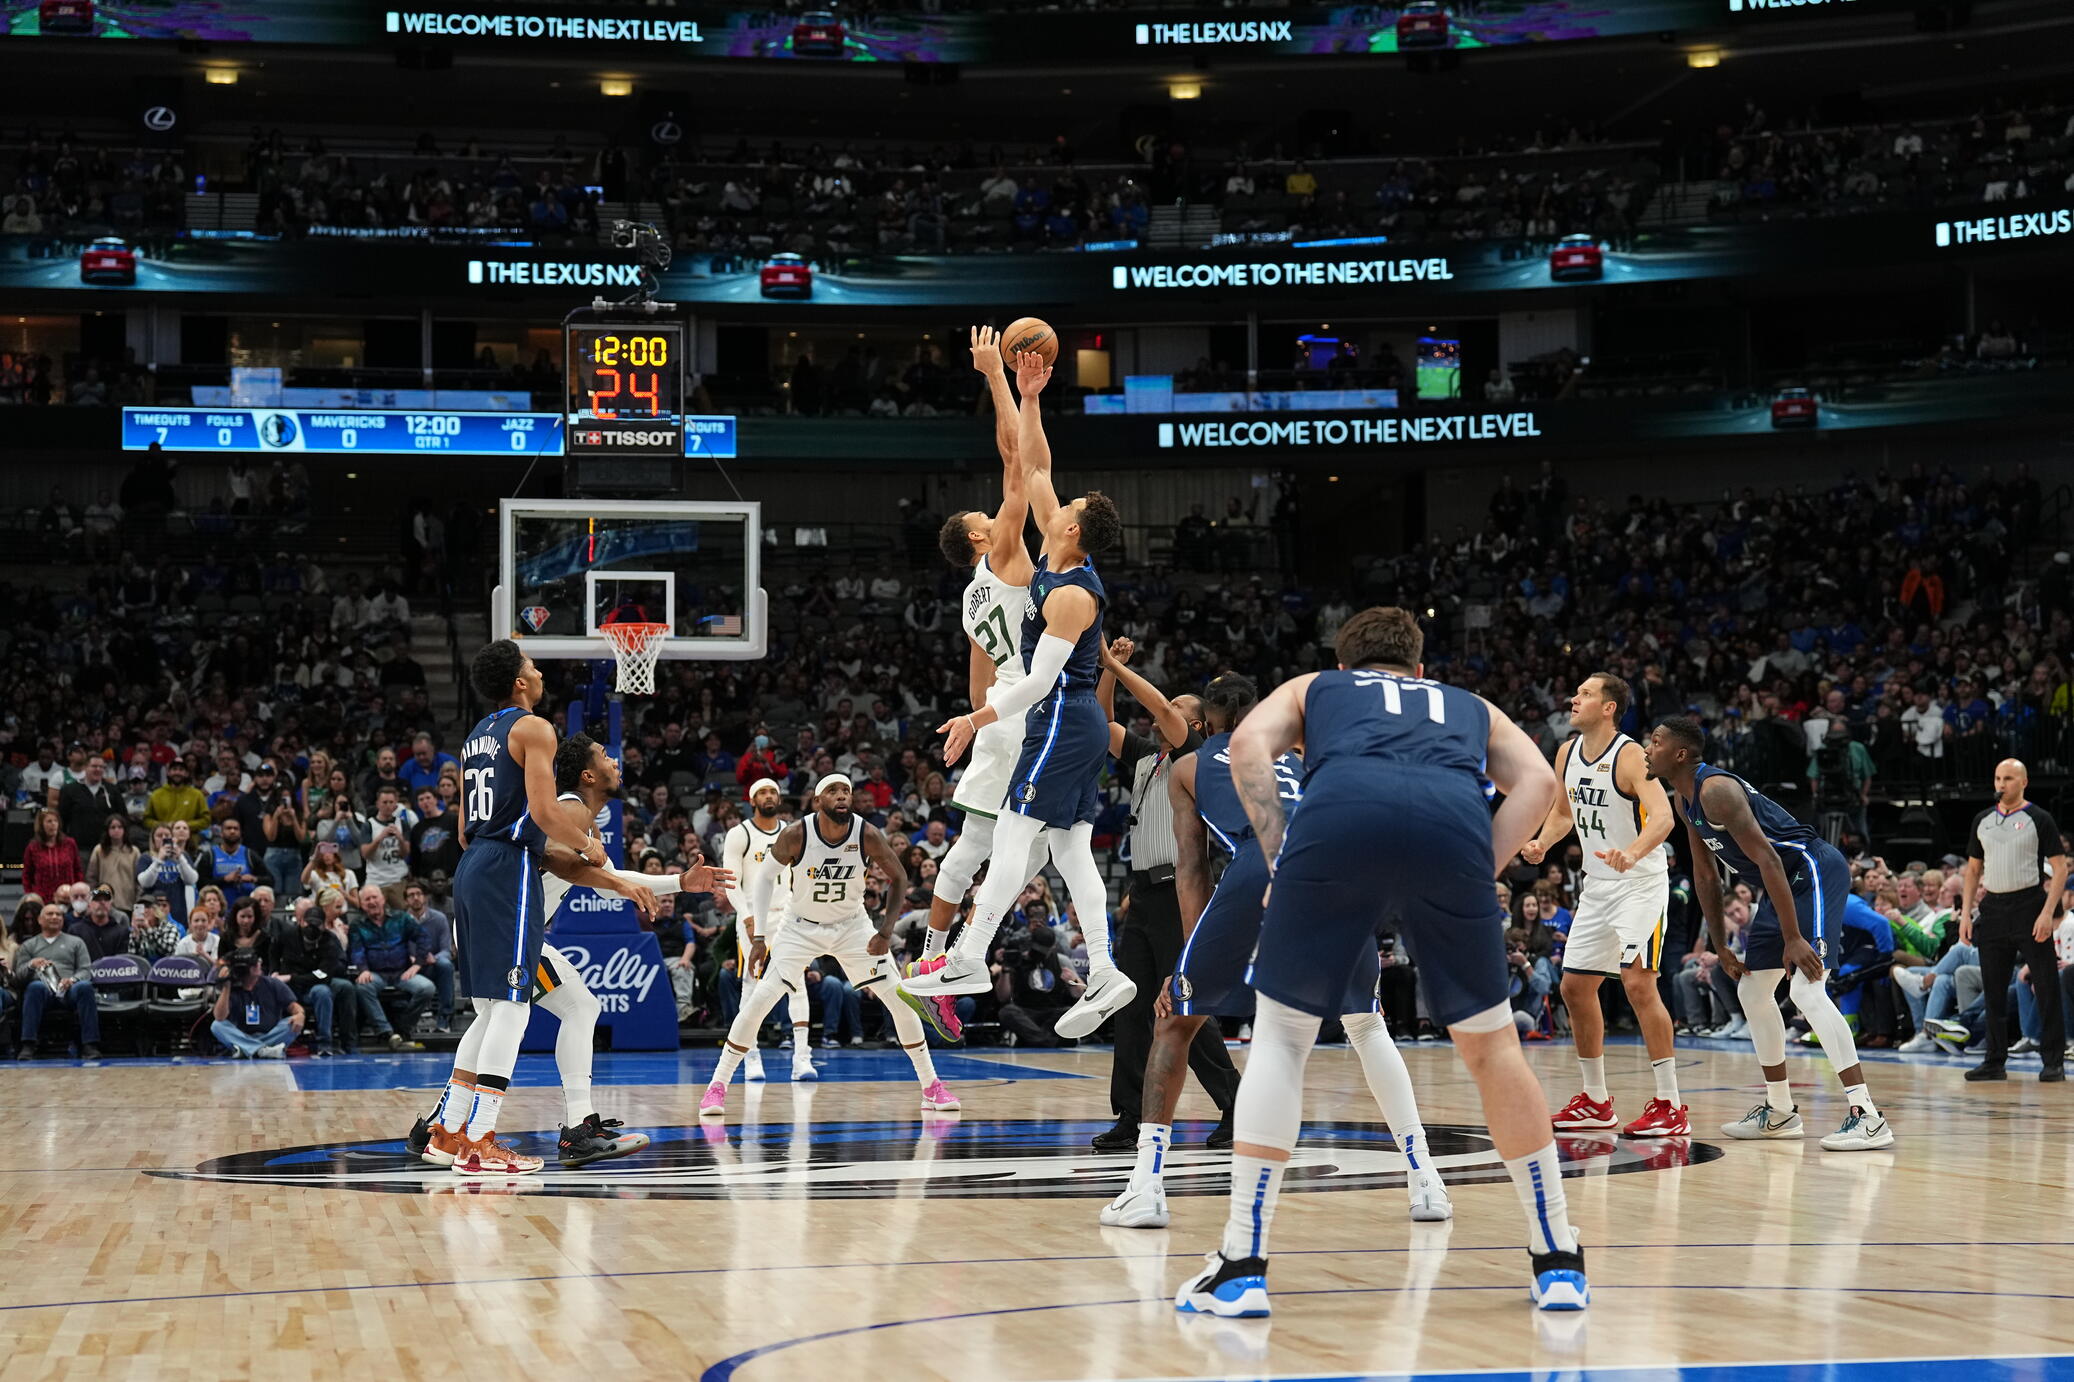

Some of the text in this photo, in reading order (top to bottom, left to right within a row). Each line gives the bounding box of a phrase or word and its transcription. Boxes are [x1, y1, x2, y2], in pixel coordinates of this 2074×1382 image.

[402, 12, 704, 42] WELCOME TO THE NEXT LEVEL
[1152, 21, 1293, 44] THE LEXUS NX
[1953, 209, 2072, 244] THE LEXUS
[487, 262, 642, 287] THE LEXUS NX
[1131, 258, 1454, 288] WELCOME TO THE NEXT LEVEL
[595, 336, 668, 366] 12:00
[1010, 331, 1046, 355] Wilson
[592, 369, 659, 418] 24
[133, 413, 244, 427] TIMEOUTS FOULS
[310, 415, 386, 429] MAVERICKS
[405, 416, 461, 436] 12:00
[501, 418, 535, 431] JAZZ
[1178, 412, 1541, 446] WELCOME TO THE NEXT LEVEL
[156, 428, 168, 445] 7
[218, 428, 232, 446] 0
[341, 428, 357, 448] 0
[415, 436, 442, 448] QTR
[510, 431, 526, 450] 0
[602, 431, 677, 446] TISSOT
[690, 434, 702, 452] 7
[968, 586, 991, 621] GOBERT
[974, 604, 1016, 667] 27
[1354, 678, 1445, 724] 77
[464, 767, 495, 822] 26
[1577, 777, 1609, 807] JAZZ
[1577, 808, 1607, 840] 44
[817, 858, 856, 880] JAZZ
[569, 894, 624, 912] chime
[813, 882, 847, 903] 23
[90, 966, 139, 978] VOYAGER
[153, 967, 200, 979] VOYAGER
[597, 994, 630, 1012] RTS
